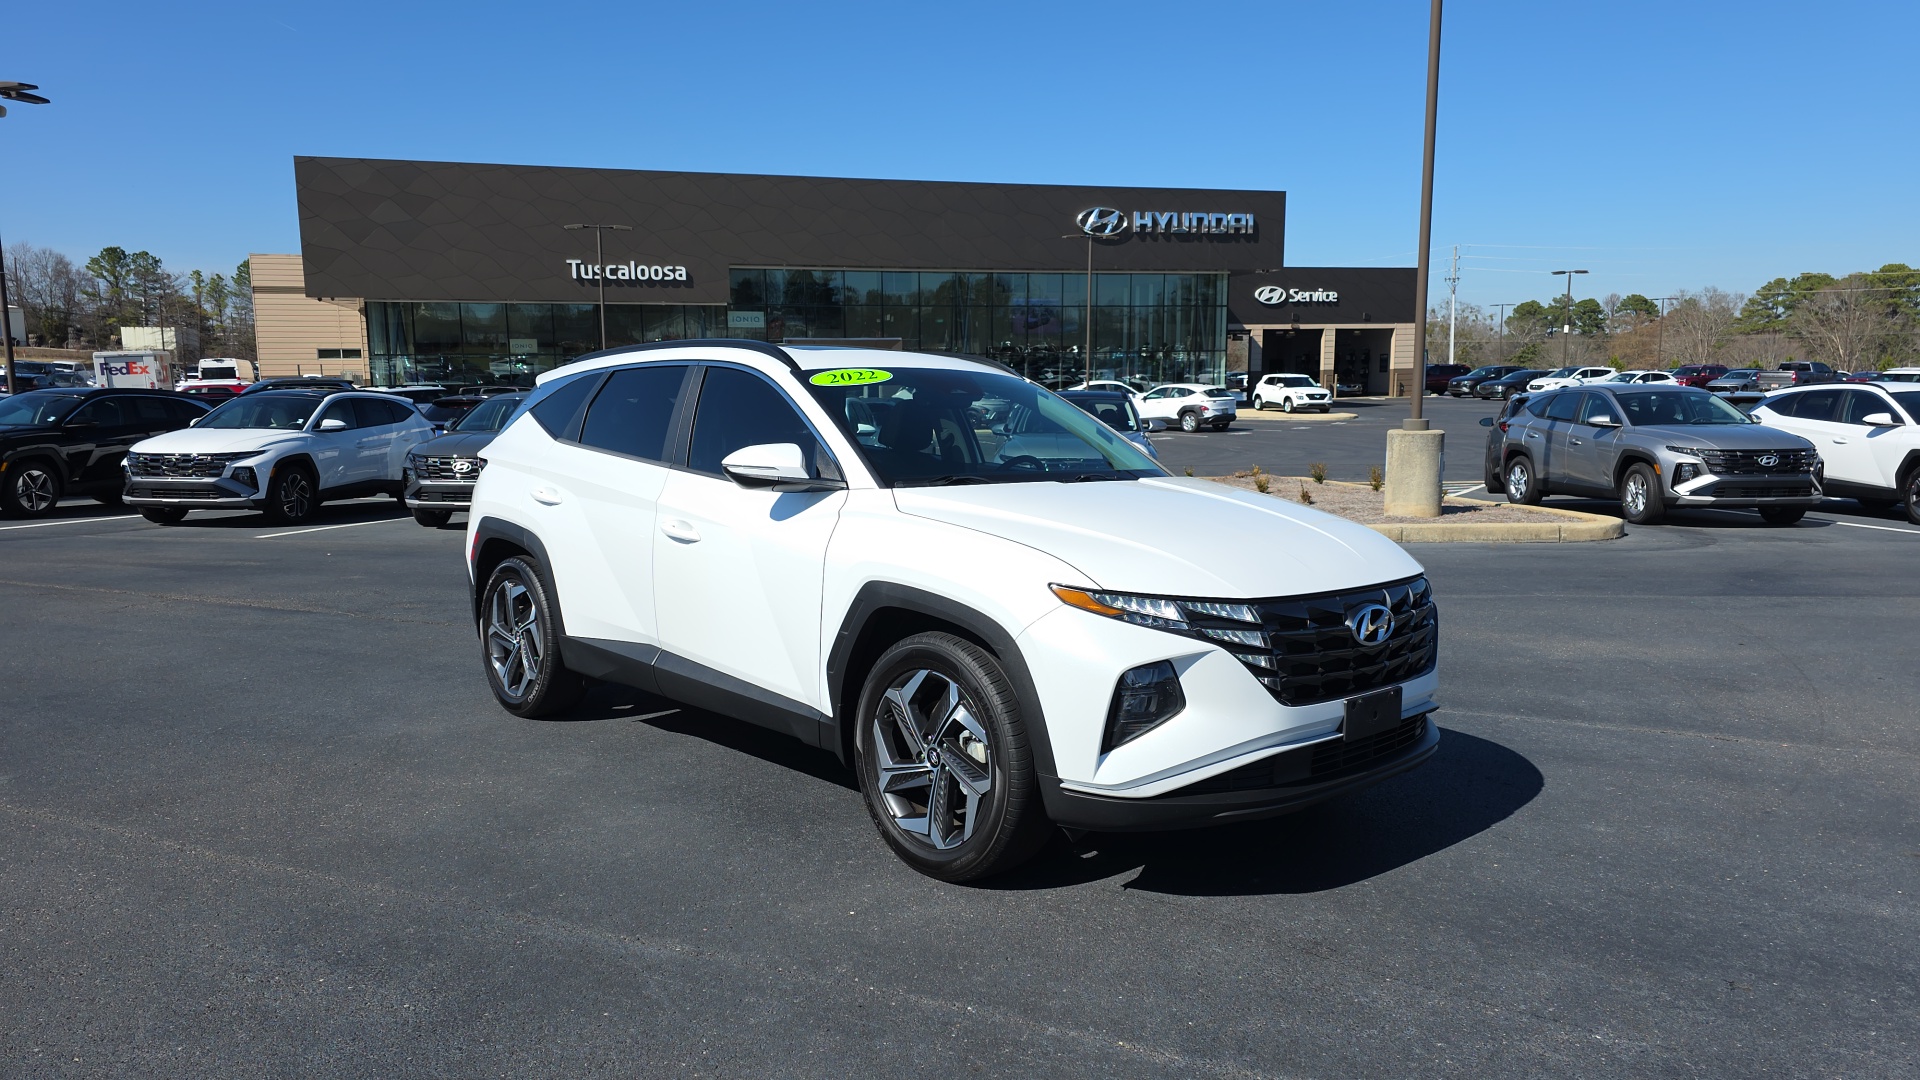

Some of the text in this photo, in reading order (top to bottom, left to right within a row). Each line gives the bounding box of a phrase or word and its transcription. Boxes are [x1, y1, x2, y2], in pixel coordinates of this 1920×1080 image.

[1133, 211, 1254, 234] HYUNDAI
[566, 259, 687, 281] Tuscaloosa
[1289, 287, 1338, 302] Service
[99, 361, 151, 376] FedEx
[827, 370, 878, 384] 2022
